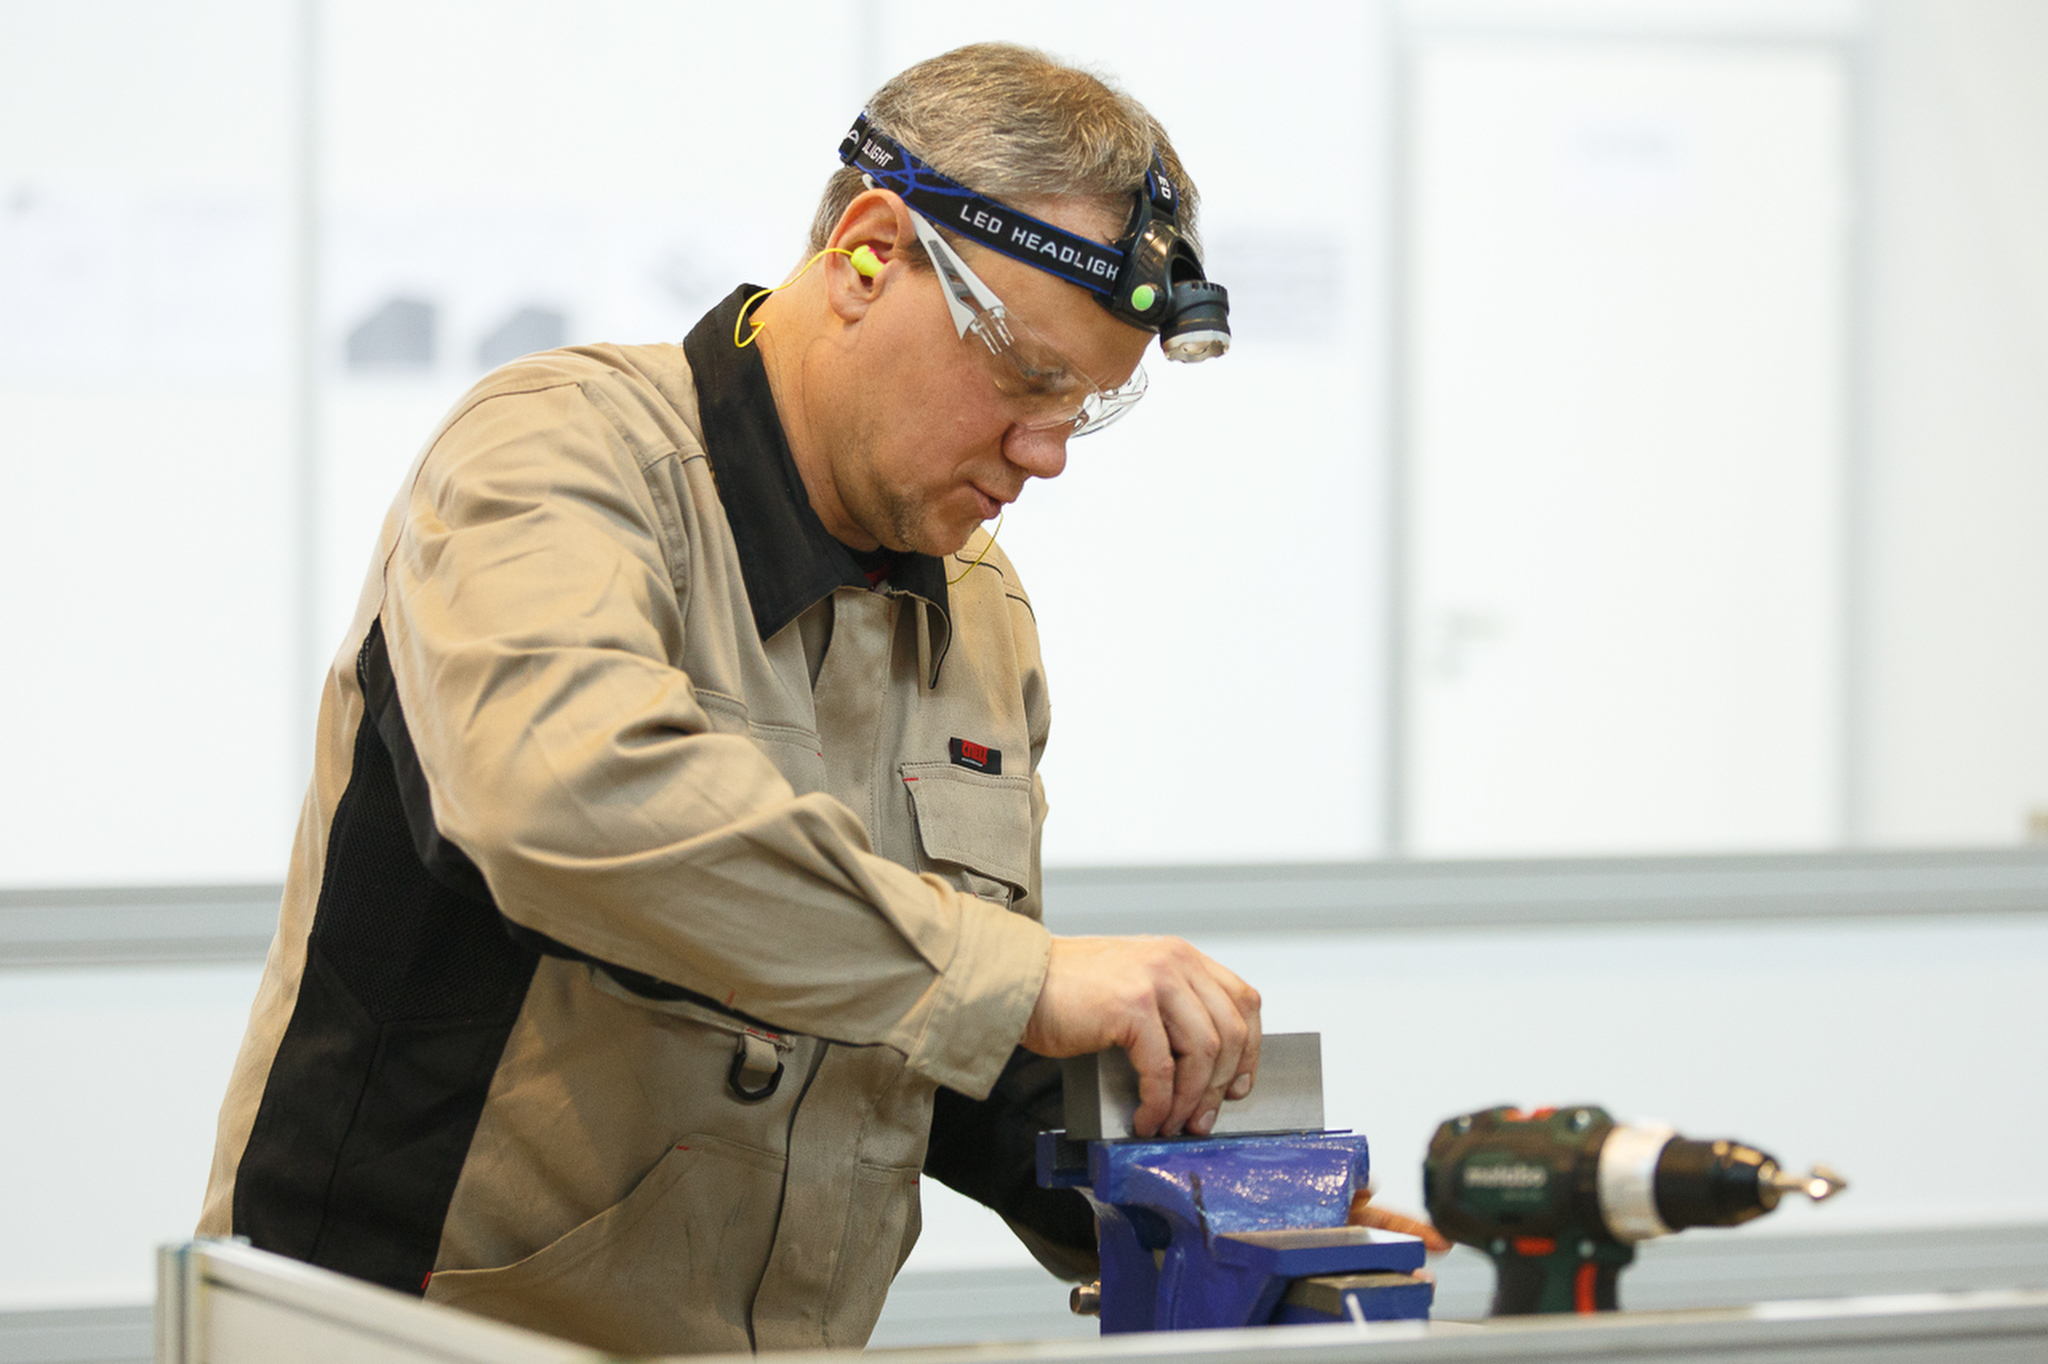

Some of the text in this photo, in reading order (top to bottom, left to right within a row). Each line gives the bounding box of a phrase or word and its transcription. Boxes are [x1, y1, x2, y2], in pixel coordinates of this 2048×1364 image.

[1157, 173, 1172, 200] ED
[960, 204, 1119, 281] LED HEADLIGH
